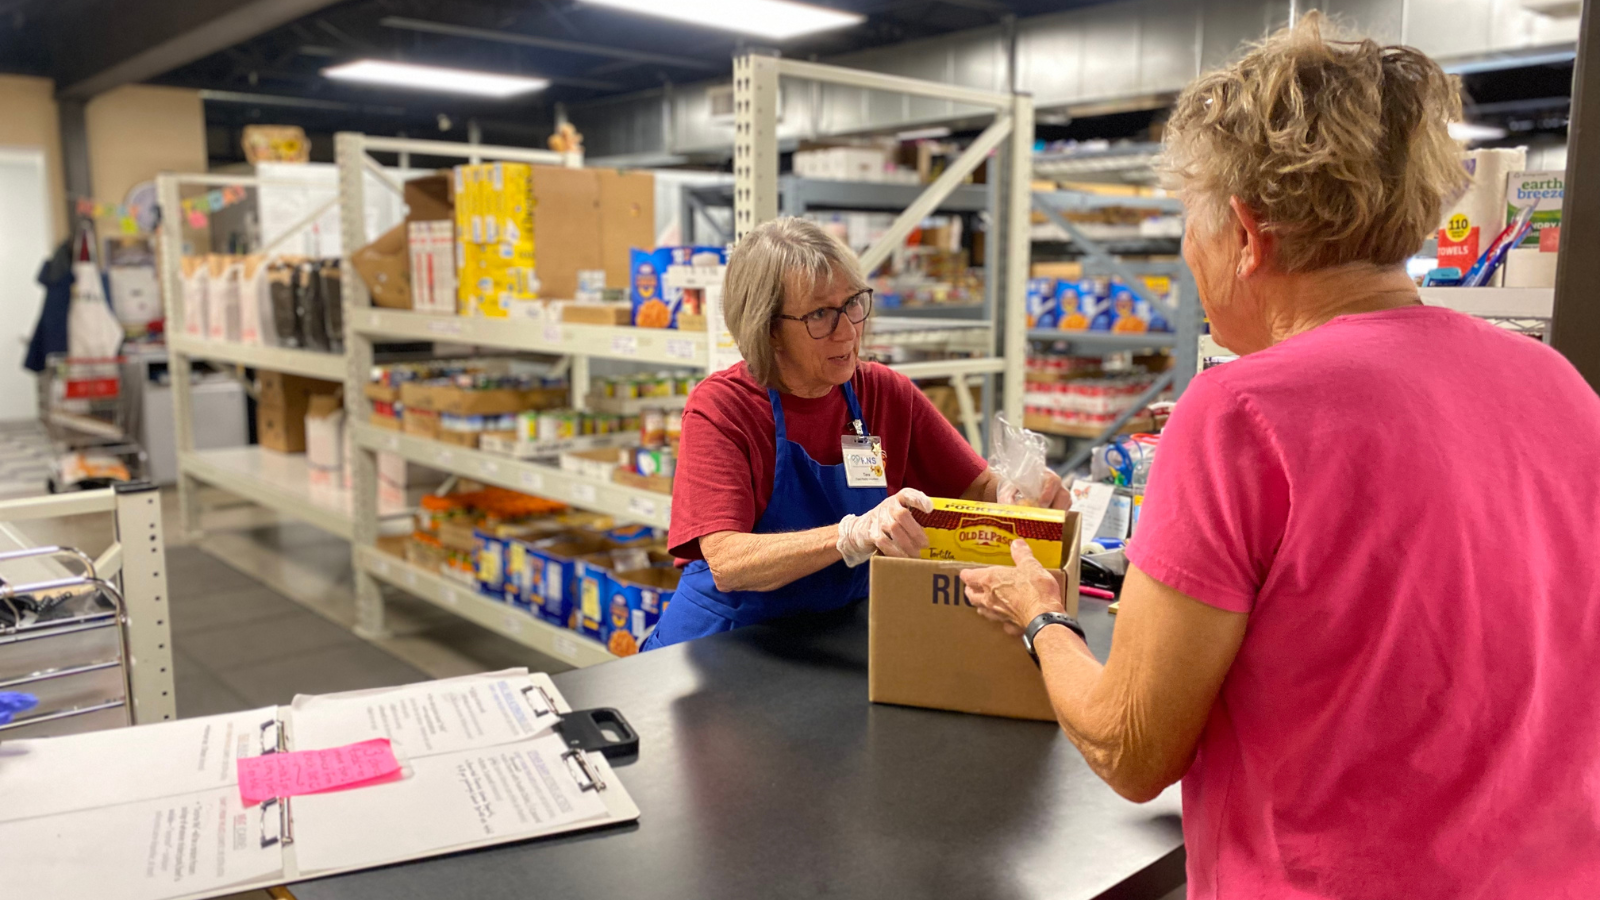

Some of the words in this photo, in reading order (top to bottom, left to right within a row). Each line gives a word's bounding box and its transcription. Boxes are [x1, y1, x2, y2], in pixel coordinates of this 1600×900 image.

[1522, 177, 1562, 189] earth
[1449, 219, 1468, 230] 110
[928, 547, 956, 560] Tortilla
[932, 573, 974, 607] RI
